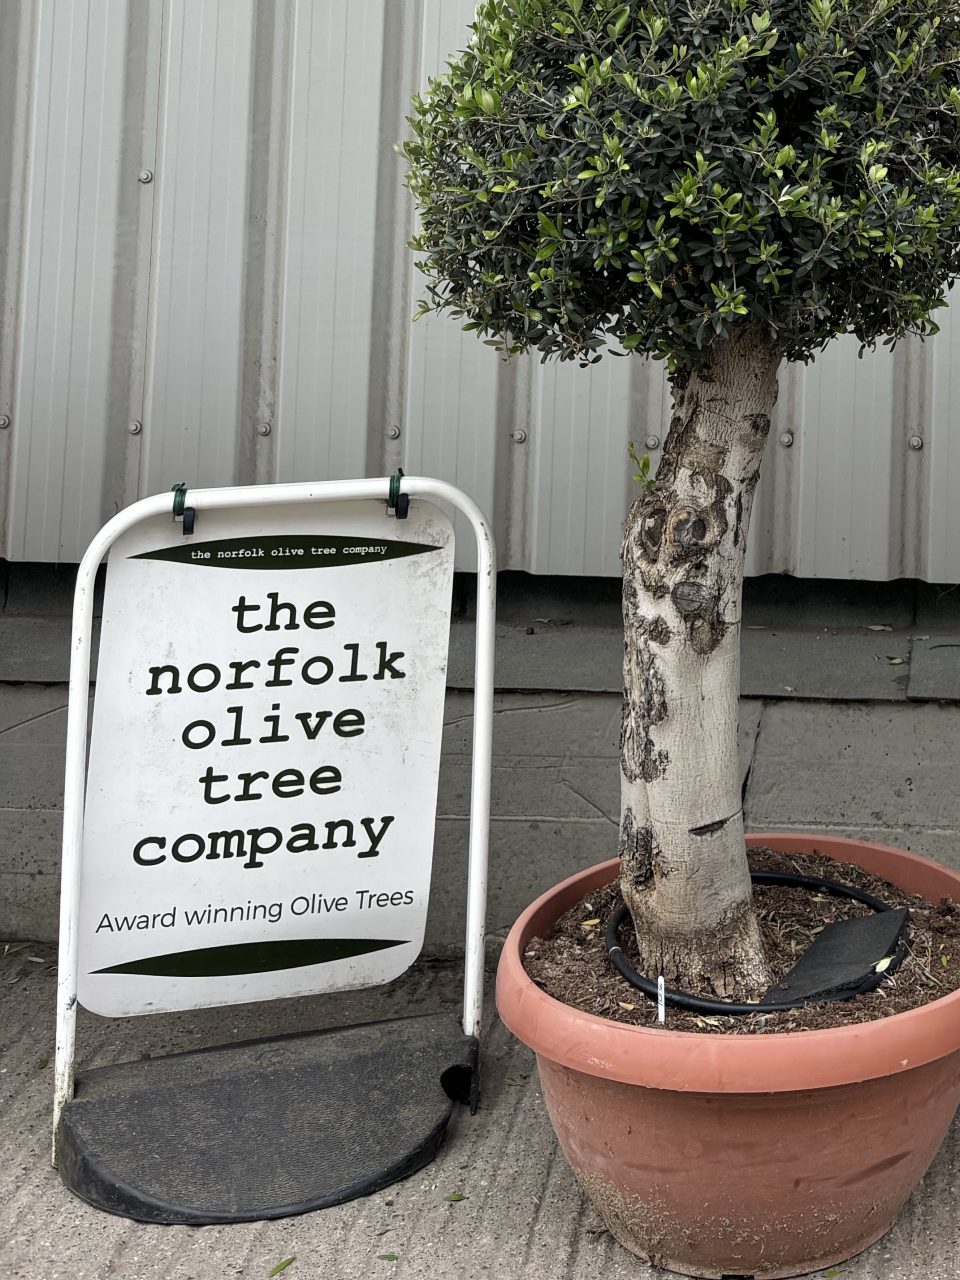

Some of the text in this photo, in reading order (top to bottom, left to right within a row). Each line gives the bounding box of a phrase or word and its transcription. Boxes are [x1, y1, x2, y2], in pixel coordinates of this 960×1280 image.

[191, 545, 388, 559] the norfolk olive tree company
[231, 592, 336, 634] the
[145, 641, 406, 696] norfolk
[181, 703, 366, 750] olive
[198, 765, 342, 805] tree
[132, 815, 395, 869] company
[95, 889, 414, 934] Award winning Olive Trees
